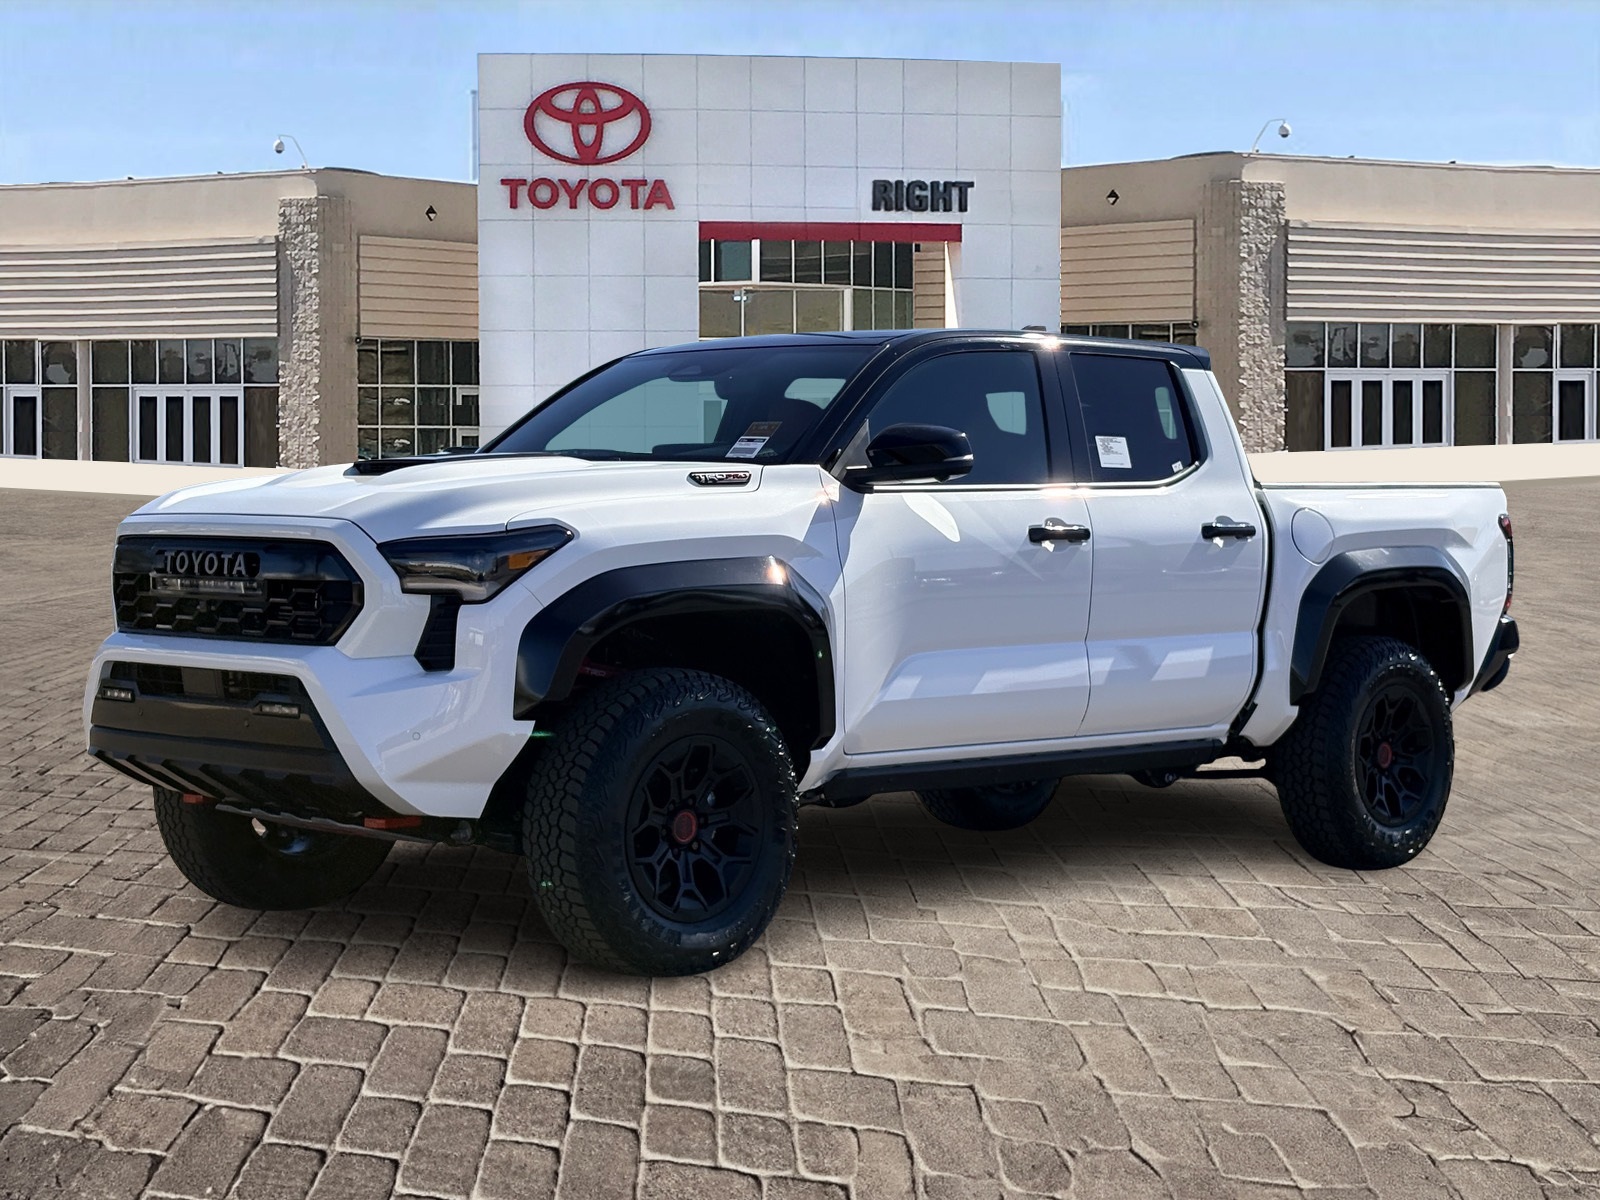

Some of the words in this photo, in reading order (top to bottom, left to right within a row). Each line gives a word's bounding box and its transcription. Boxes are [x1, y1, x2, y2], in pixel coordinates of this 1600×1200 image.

[500, 178, 675, 210] TOYOTA
[872, 179, 974, 213] RIGHT
[164, 551, 247, 576] TOYOTA
